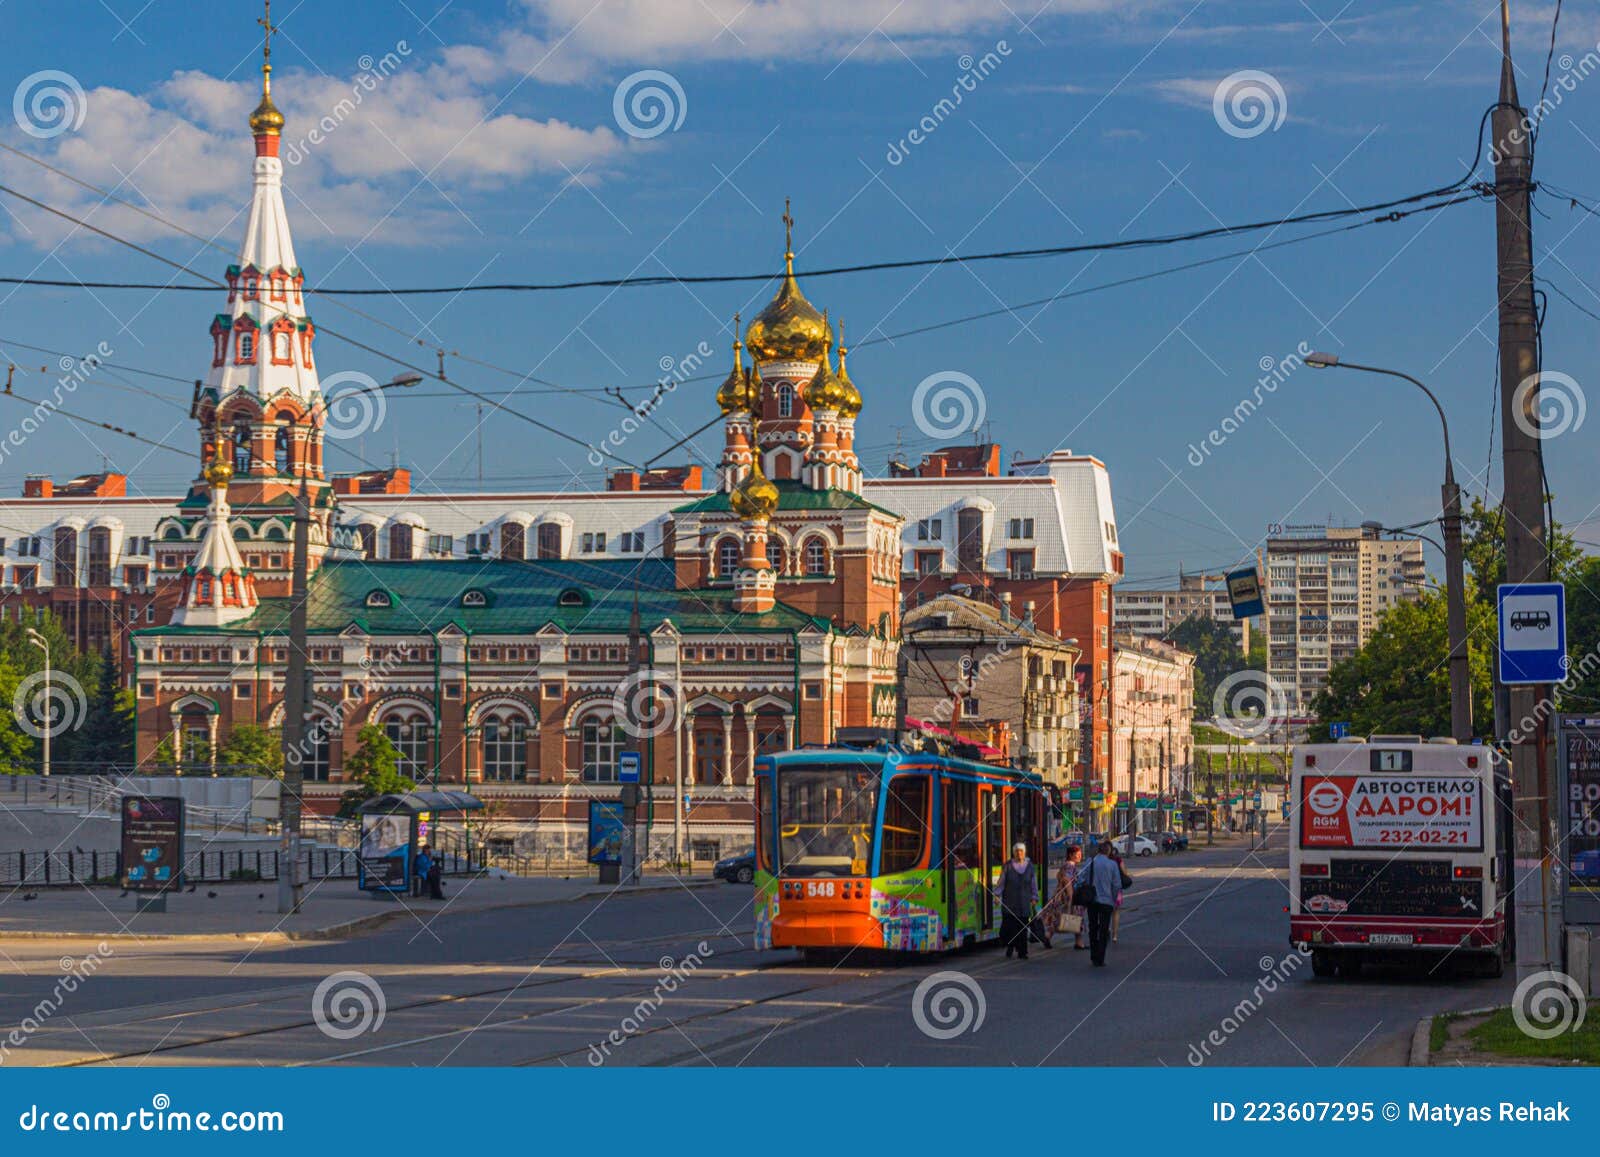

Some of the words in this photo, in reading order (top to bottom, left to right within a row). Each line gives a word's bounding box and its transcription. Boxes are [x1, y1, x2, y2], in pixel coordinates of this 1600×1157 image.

[1387, 753, 1394, 769] 1
[1357, 781, 1475, 794] АВТОСТЕКЛО
[1355, 795, 1472, 817] ДАРОМ!
[1380, 829, 1469, 844] 232-02-21
[807, 881, 835, 897] 548
